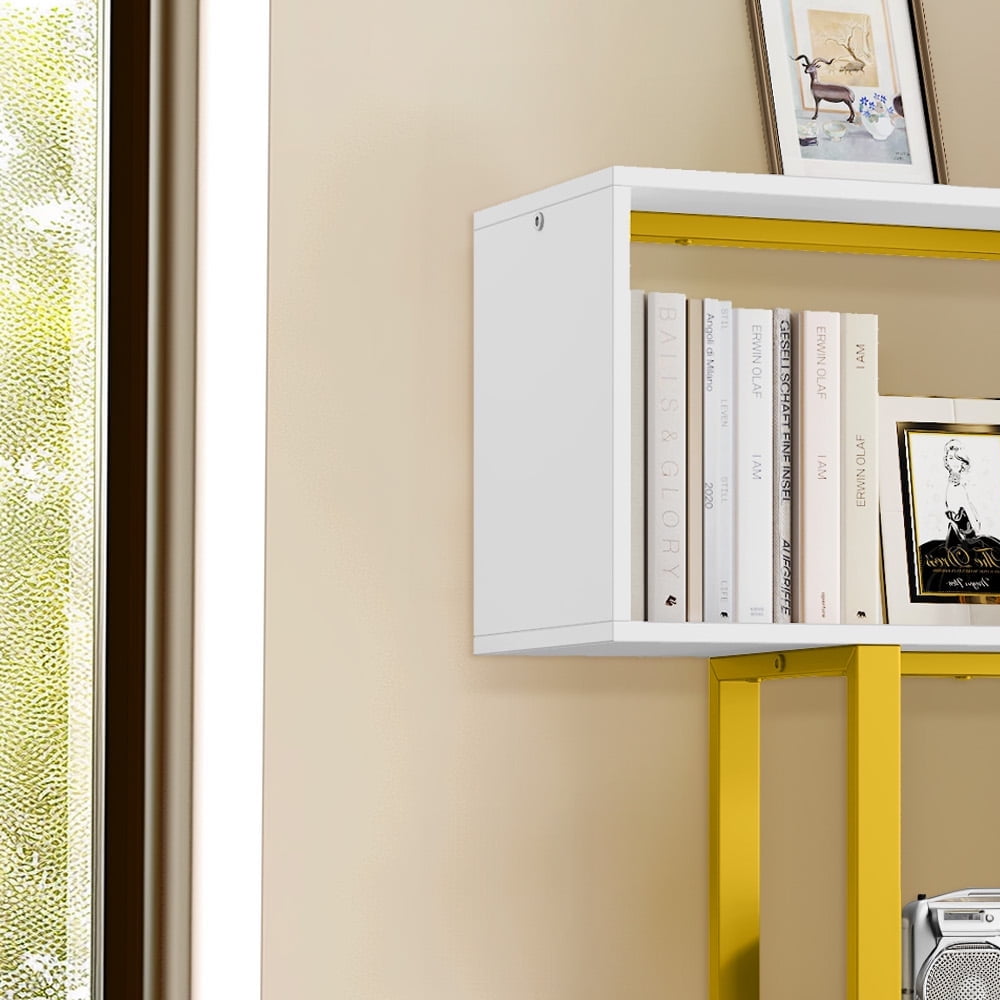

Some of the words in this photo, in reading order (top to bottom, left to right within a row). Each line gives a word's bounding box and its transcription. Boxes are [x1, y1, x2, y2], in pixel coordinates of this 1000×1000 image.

[705, 313, 714, 344] Angoli
[752, 325, 762, 363] ERWIN
[706, 347, 714, 356] di
[817, 326, 826, 364] ERWIN
[856, 344, 864, 362] AM
[706, 360, 714, 392] Milano
[752, 367, 762, 399] OLAF
[817, 368, 826, 400] OLAF
[662, 431, 678, 442] &
[856, 434, 865, 465] OLAF
[752, 461, 761, 480] AM
[817, 461, 826, 480] AM
[704, 482, 713, 509] 2020
[856, 469, 865, 507] ERWIN
[662, 461, 679, 578] GLORY
